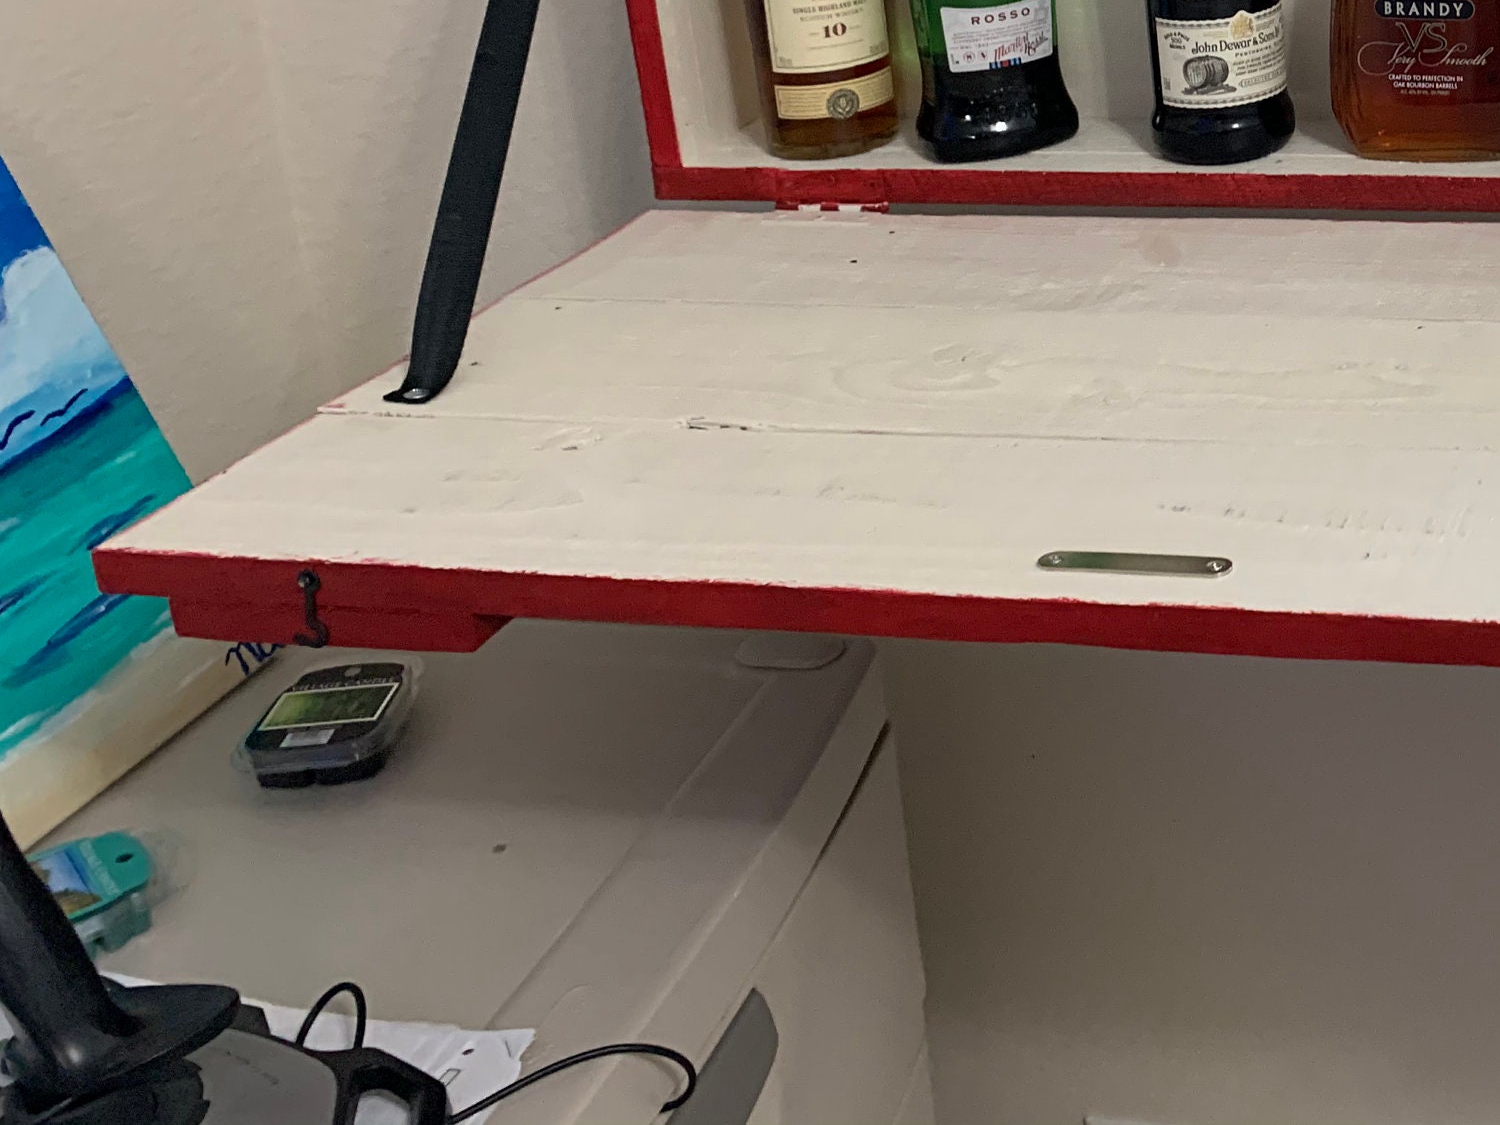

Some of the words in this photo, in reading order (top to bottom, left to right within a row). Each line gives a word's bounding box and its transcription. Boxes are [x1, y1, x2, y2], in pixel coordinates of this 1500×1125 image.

[971, 7, 1031, 25] ROSSO
[1384, 1, 1464, 17] BRANDY
[824, 22, 847, 38] 10
[1395, 22, 1448, 53] VS
[1191, 41, 1217, 54] John
[1219, 38, 1251, 51] Dewar
[1252, 37, 1258, 46] &
[1357, 41, 1417, 75] Very
[1418, 43, 1494, 67] Smooth
[1388, 74, 1411, 82] CRAFTED
[1422, 75, 1455, 83] PERFECTION
